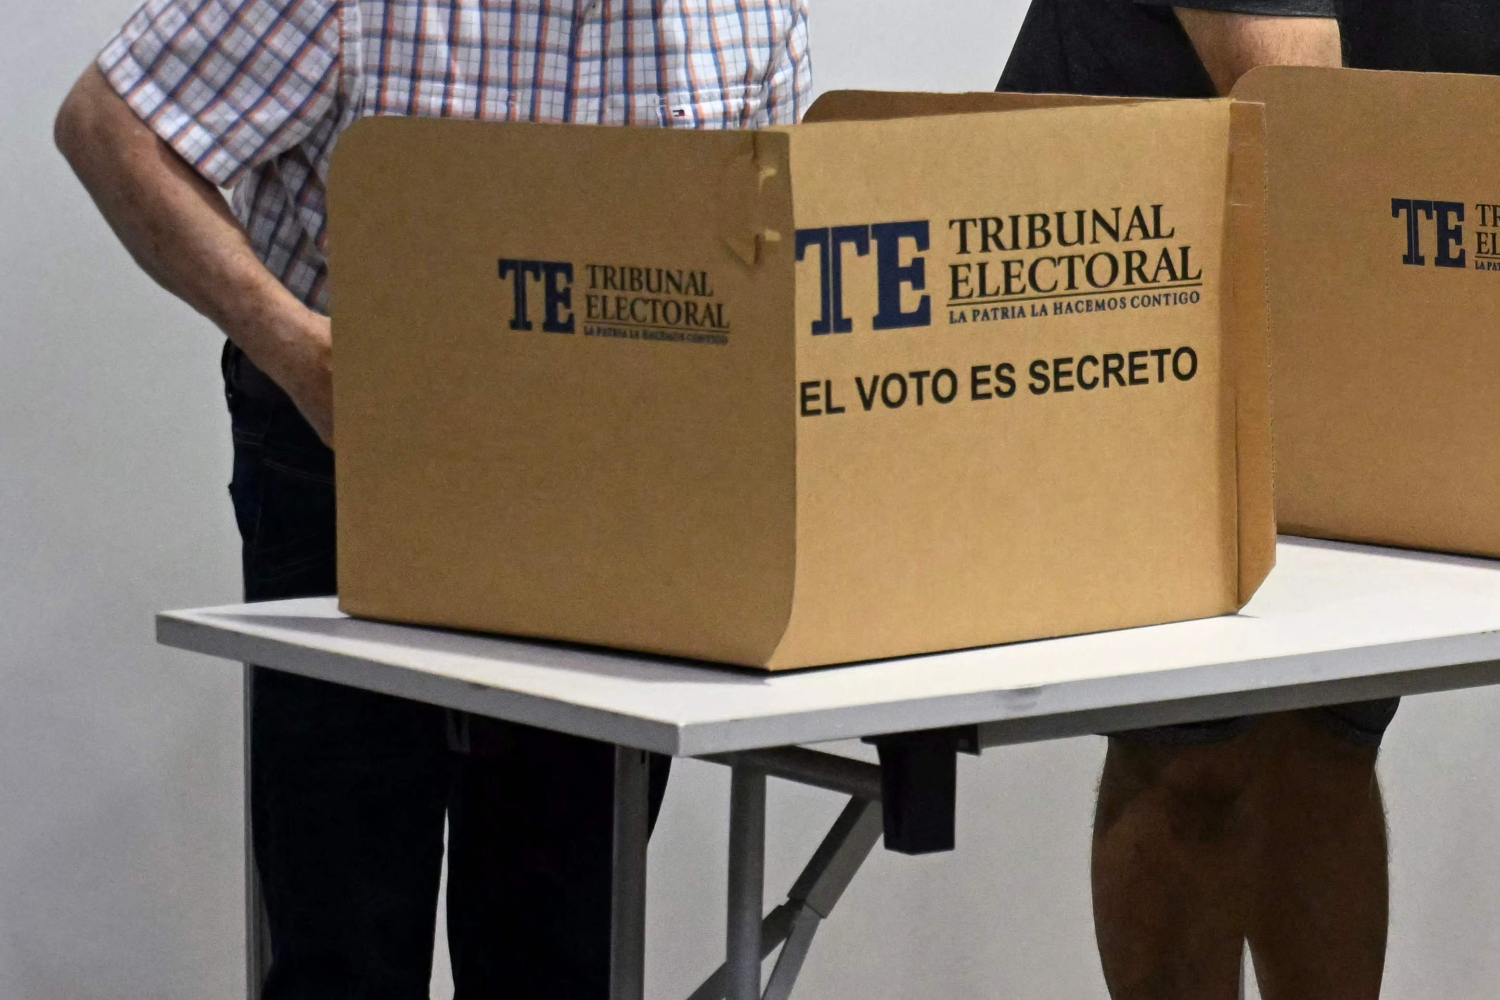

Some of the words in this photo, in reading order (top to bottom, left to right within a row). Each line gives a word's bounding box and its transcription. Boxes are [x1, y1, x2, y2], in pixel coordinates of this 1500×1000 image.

[949, 204, 1175, 255] TRIBUNAL
[1391, 198, 1466, 268] TE
[586, 264, 714, 297] TRIBUNAL
[795, 220, 931, 336] TE
[949, 246, 1203, 301] ELECTORAL
[1475, 261, 1485, 269] LA
[498, 259, 575, 334] TE
[586, 295, 730, 328] ELECTORAL
[949, 311, 967, 324] LA
[972, 304, 1026, 322] PATRIA
[1031, 303, 1048, 317] LA
[1054, 294, 1126, 315] HACEMOS
[1131, 291, 1200, 308] CONTIGO
[800, 380, 845, 417] EL
[856, 368, 958, 411] VOTO
[971, 362, 1016, 401] ES
[1028, 347, 1198, 396] SECRETO
